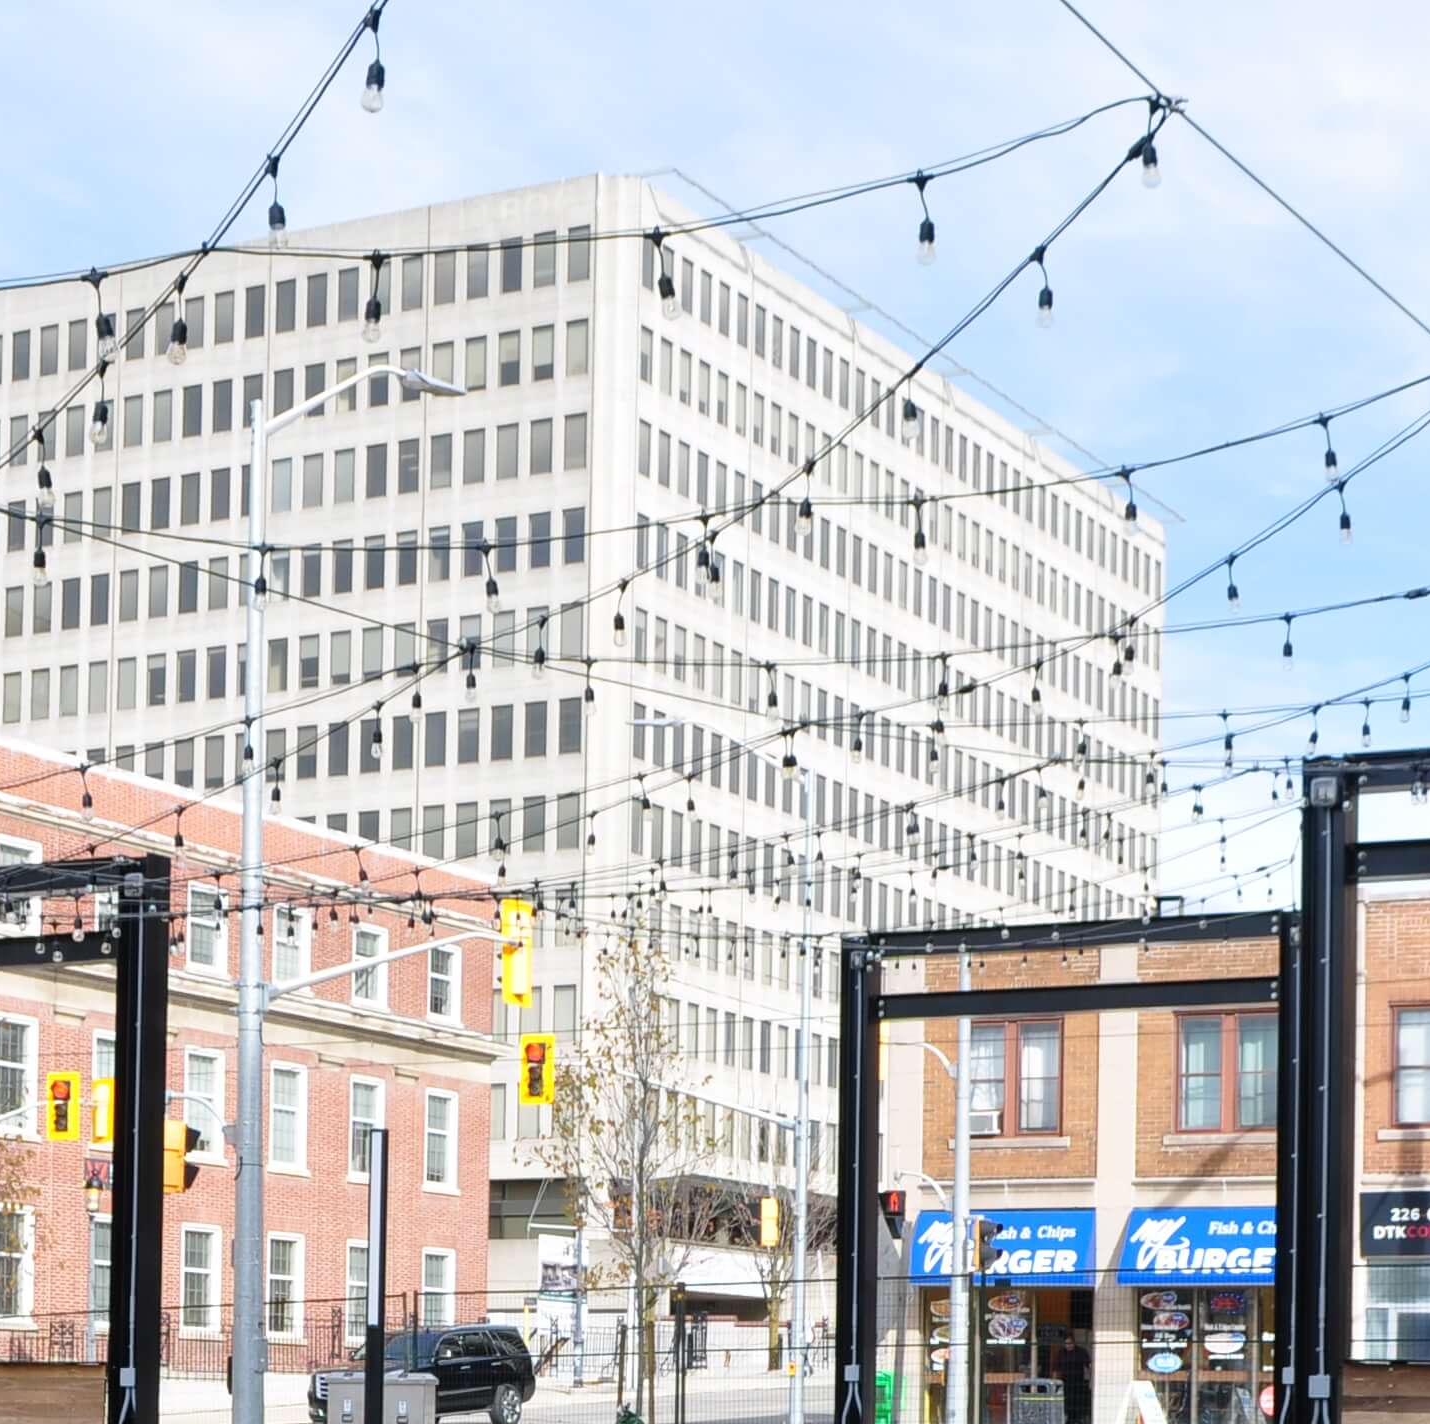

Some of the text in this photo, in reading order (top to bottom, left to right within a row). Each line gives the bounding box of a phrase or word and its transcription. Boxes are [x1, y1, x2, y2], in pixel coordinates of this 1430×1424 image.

[1037, 1224, 1077, 1242] Chips
[1208, 1220, 1239, 1235] Fish
[1241, 1220, 1254, 1235] &
[1154, 1247, 1277, 1275] BURGE
